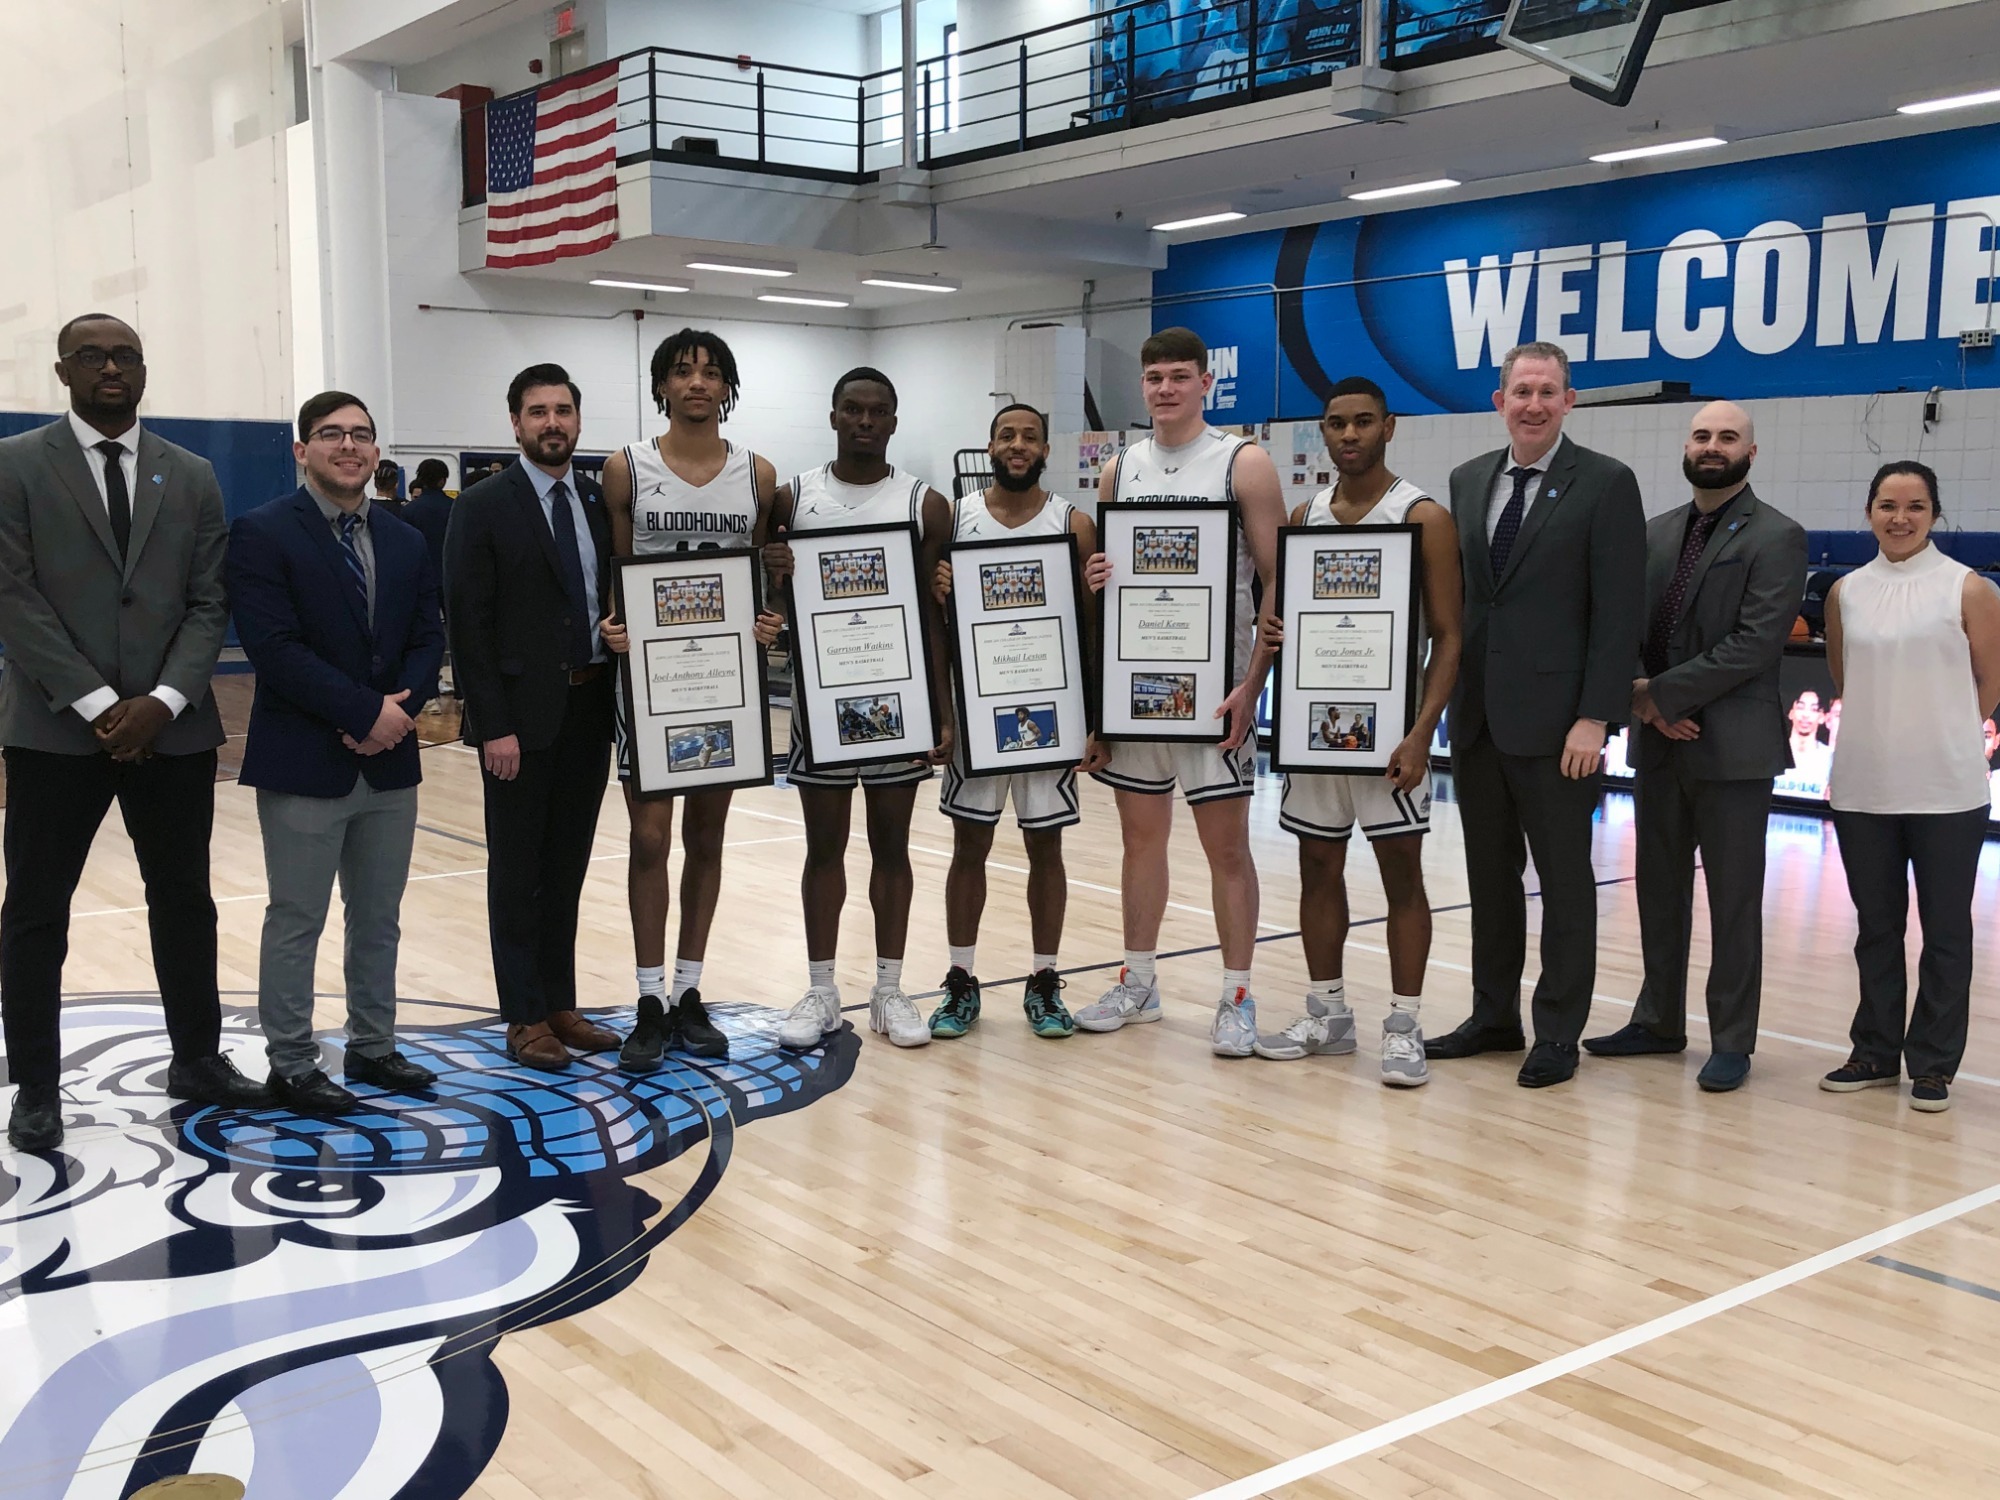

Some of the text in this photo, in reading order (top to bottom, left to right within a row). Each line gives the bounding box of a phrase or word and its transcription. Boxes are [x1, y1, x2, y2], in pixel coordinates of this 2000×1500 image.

[1332, 23, 1351, 35] JAY
[1444, 195, 2000, 370] WELCOME
[1207, 346, 1238, 379] HN
[647, 512, 748, 534] BLOODHOUNDS
[1138, 619, 1164, 629] Daniel
[826, 641, 894, 655] Garrison Watkins
[1340, 647, 1363, 657] Jones
[992, 653, 1021, 664] Mikhail
[706, 668, 736, 678] Alleyne
